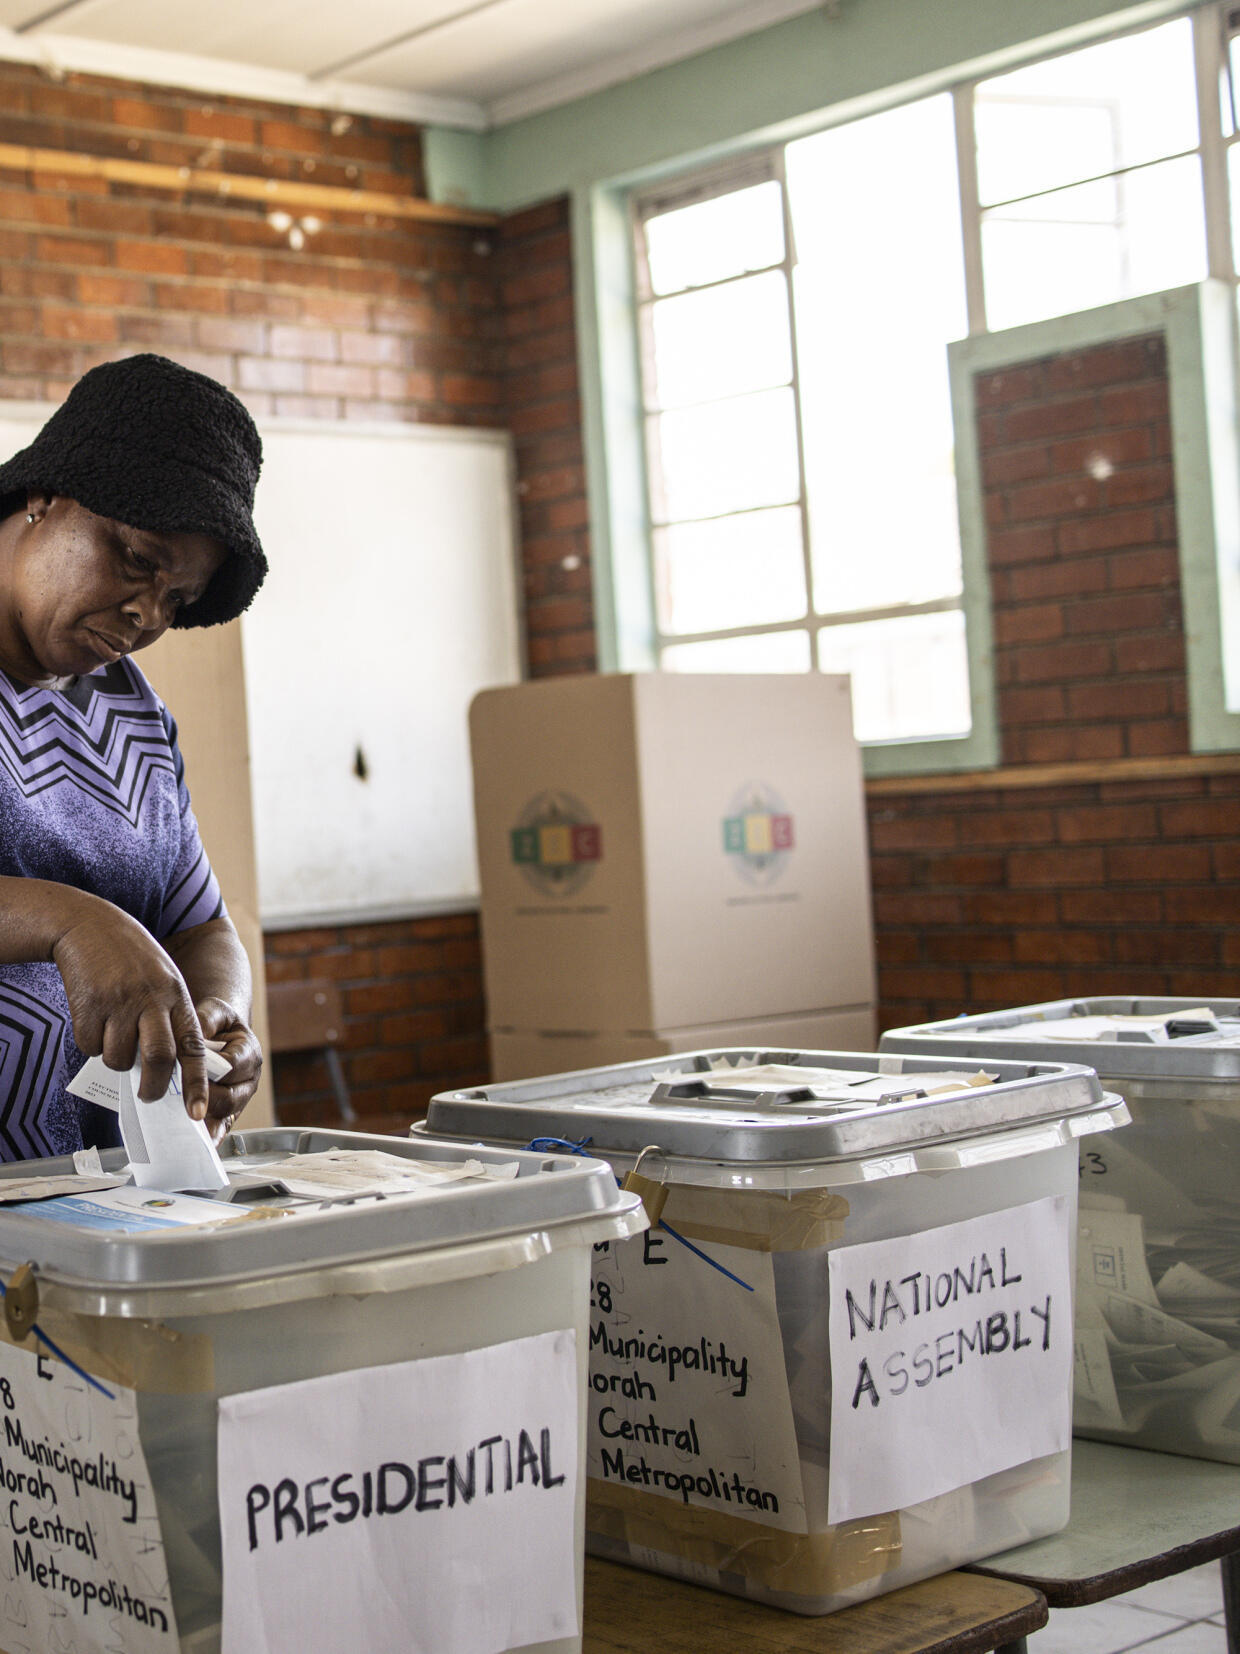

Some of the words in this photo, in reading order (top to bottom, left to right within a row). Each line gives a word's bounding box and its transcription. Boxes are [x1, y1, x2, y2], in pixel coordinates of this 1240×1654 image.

[643, 1227, 668, 1265] E
[845, 1246, 1022, 1341] NATIONAL
[588, 1371, 657, 1401] orah
[589, 1321, 748, 1397] Municipality
[851, 1295, 1051, 1410] ASSEMBLY
[598, 1406, 700, 1456] Central
[4, 1416, 138, 1524] Municipality
[246, 1426, 566, 1552] PRESIDENTIAL
[601, 1448, 779, 1513] Metropolitan
[10, 1499, 97, 1560] Central
[13, 1540, 168, 1632] Metropolitan
